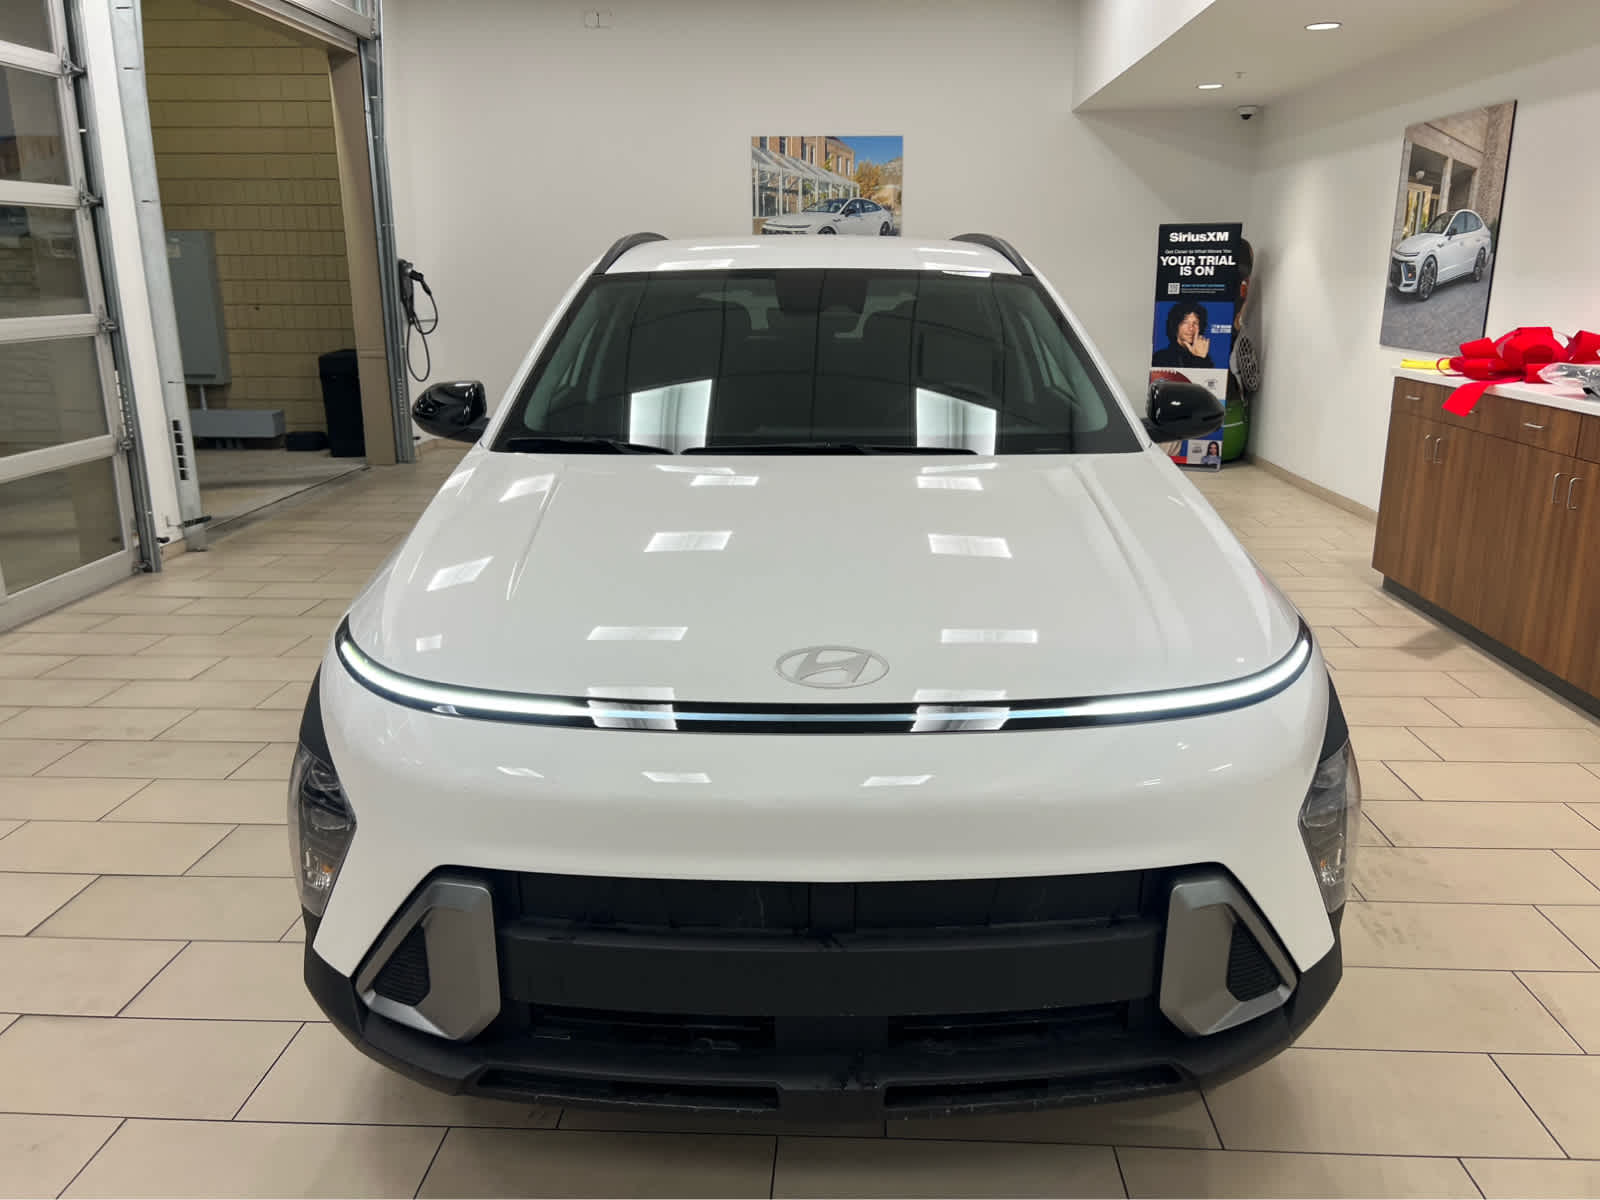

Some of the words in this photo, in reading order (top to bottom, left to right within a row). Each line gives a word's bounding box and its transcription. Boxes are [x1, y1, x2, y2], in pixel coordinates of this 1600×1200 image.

[1169, 231, 1229, 242] SiriusXM
[1160, 255, 1196, 266] YOUR
[1198, 255, 1236, 266] TRIAL
[1179, 266, 1192, 276] IS
[1194, 266, 1215, 276] ON
